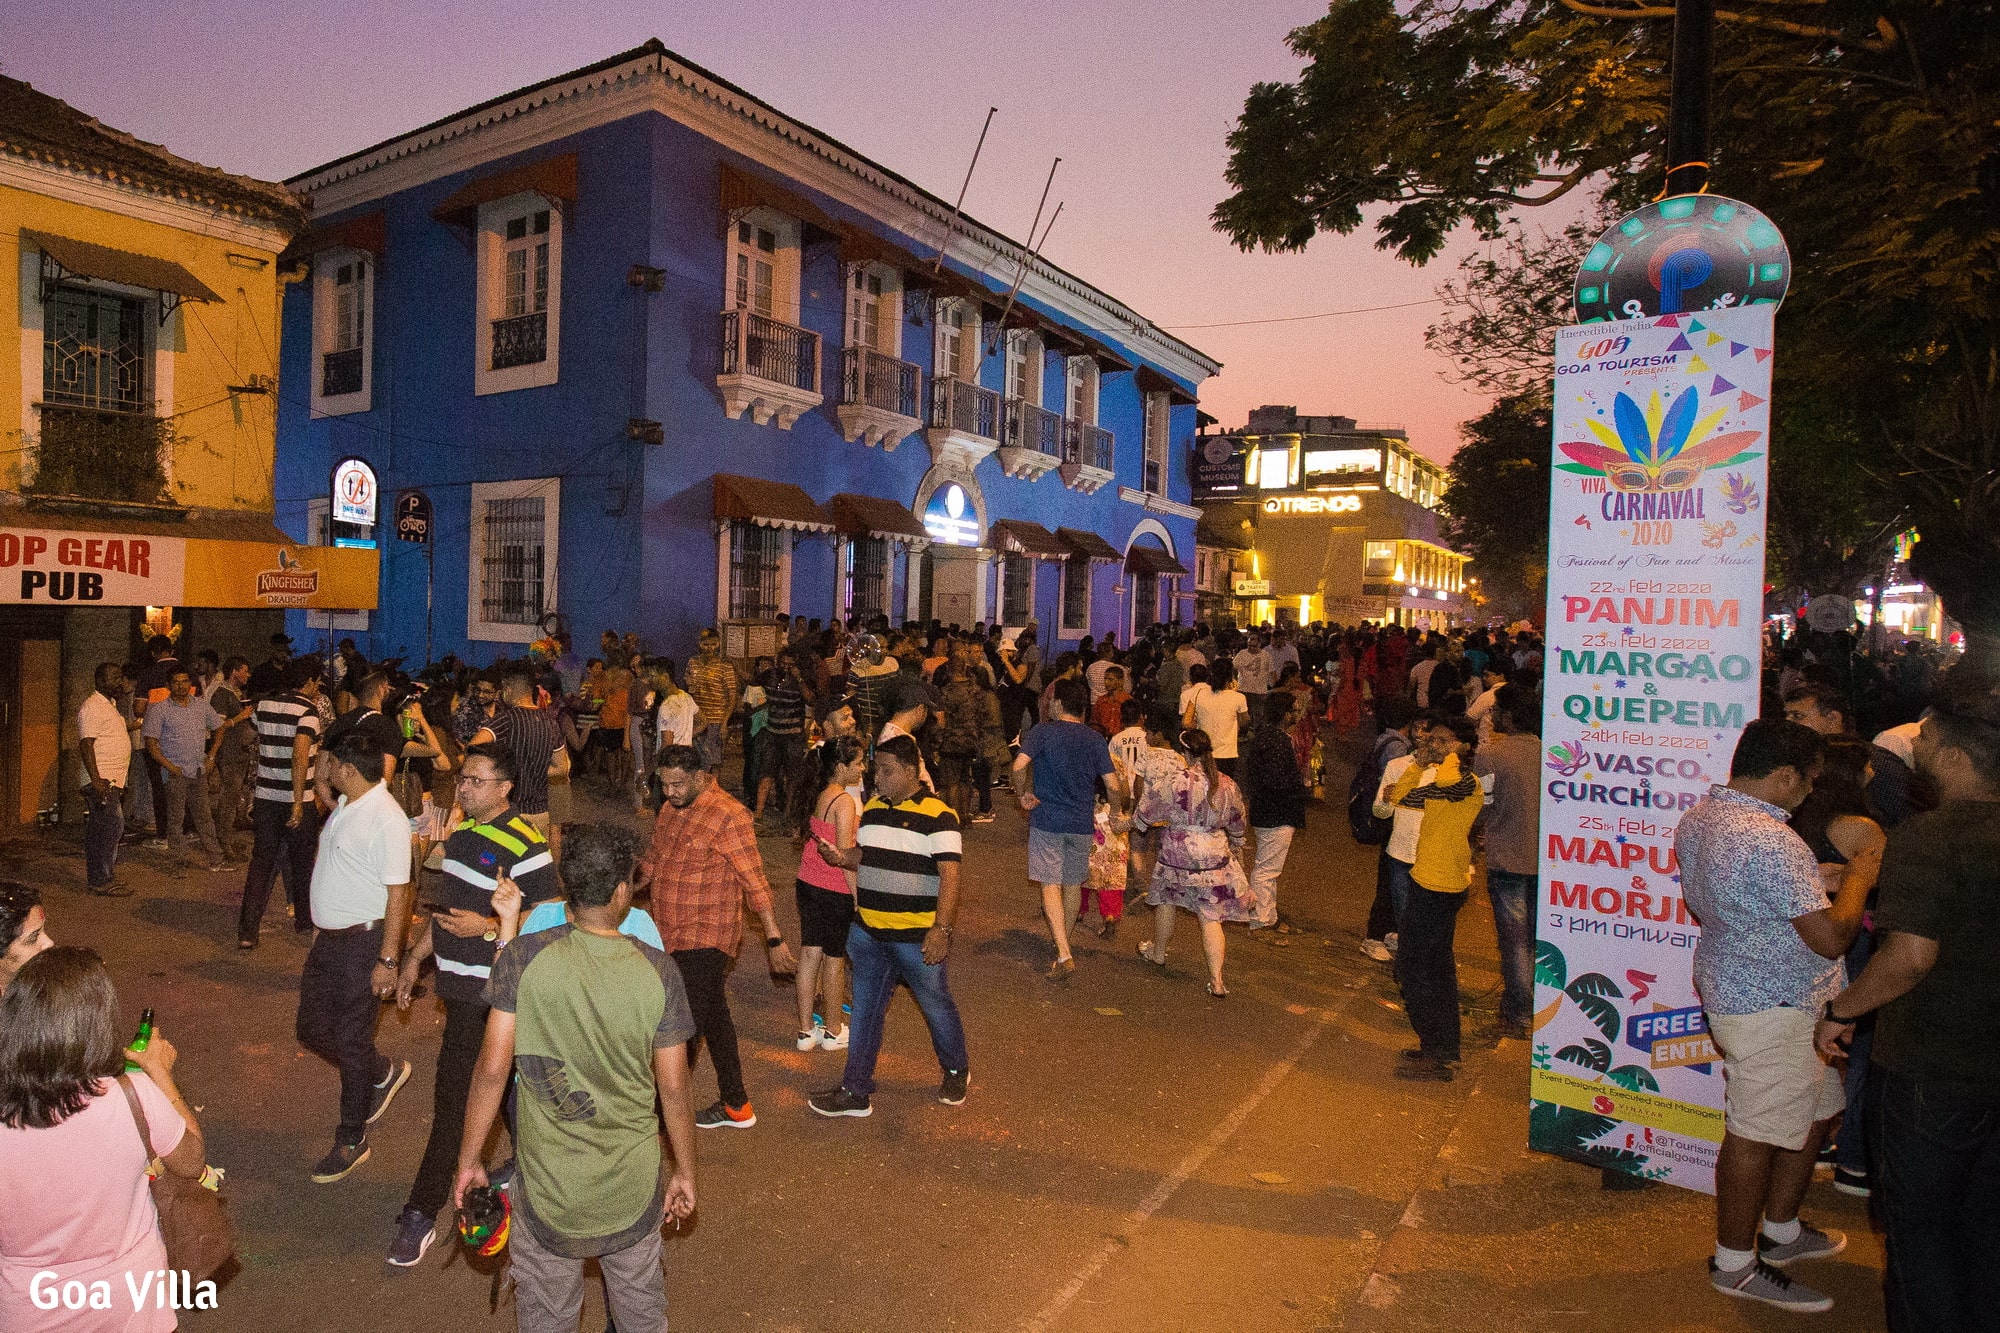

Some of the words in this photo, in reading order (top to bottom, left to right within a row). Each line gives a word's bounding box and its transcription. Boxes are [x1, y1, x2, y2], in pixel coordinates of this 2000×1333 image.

[1561, 325, 1618, 338] Incredible
[1557, 364, 1590, 375] GOA
[1598, 354, 1677, 371] TOURISM
[1623, 366, 1677, 377] PRESENTS
[1199, 463, 1241, 472] CUSTOMS
[1200, 473, 1240, 481] MUSEUM
[1581, 477, 1607, 494] VIVA
[409, 497, 419, 511] P
[1280, 496, 1361, 513] TRENDS
[1601, 488, 1705, 522] CARNAVAL
[1631, 521, 1673, 545] 2020
[57, 538, 150, 578] GEAR
[1557, 555, 1617, 568] Festival
[1617, 556, 1633, 570] of
[1636, 554, 1671, 567] Fun
[1675, 555, 1705, 565] and
[1712, 554, 1754, 565] Music
[21, 570, 103, 600] PUB
[261, 574, 315, 590] KINGFISHER
[1667, 584, 1711, 593] 2020
[267, 595, 307, 604] DRAUGHT
[1565, 596, 1740, 627] PANJIM
[1661, 638, 1710, 650] 2020
[1560, 650, 1750, 681] MARGAO
[1643, 683, 1658, 696] &
[1563, 694, 1745, 728] QUEPEM
[1122, 737, 1142, 745] BALE
[1581, 730, 1618, 743] 24th
[1659, 736, 1708, 749] 2020
[1594, 752, 1701, 779] VASCO
[1640, 778, 1651, 788] &
[1547, 780, 1707, 812] CURCHOR
[1548, 834, 1676, 875] MAPU
[1631, 876, 1647, 890] &
[1549, 880, 1701, 927] MORJI
[1550, 914, 1563, 927] 3
[1570, 917, 1607, 935] pm
[1613, 923, 1702, 949] onwar
[1636, 1012, 1702, 1038] FREE
[1655, 1039, 1717, 1062] ENTR
[1540, 1072, 1562, 1084] Event
[1610, 1088, 1651, 1104] Executed
[1654, 1100, 1672, 1109] and
[1675, 1103, 1721, 1120] Managed
[1635, 1142, 1714, 1168] /officialgoatou
